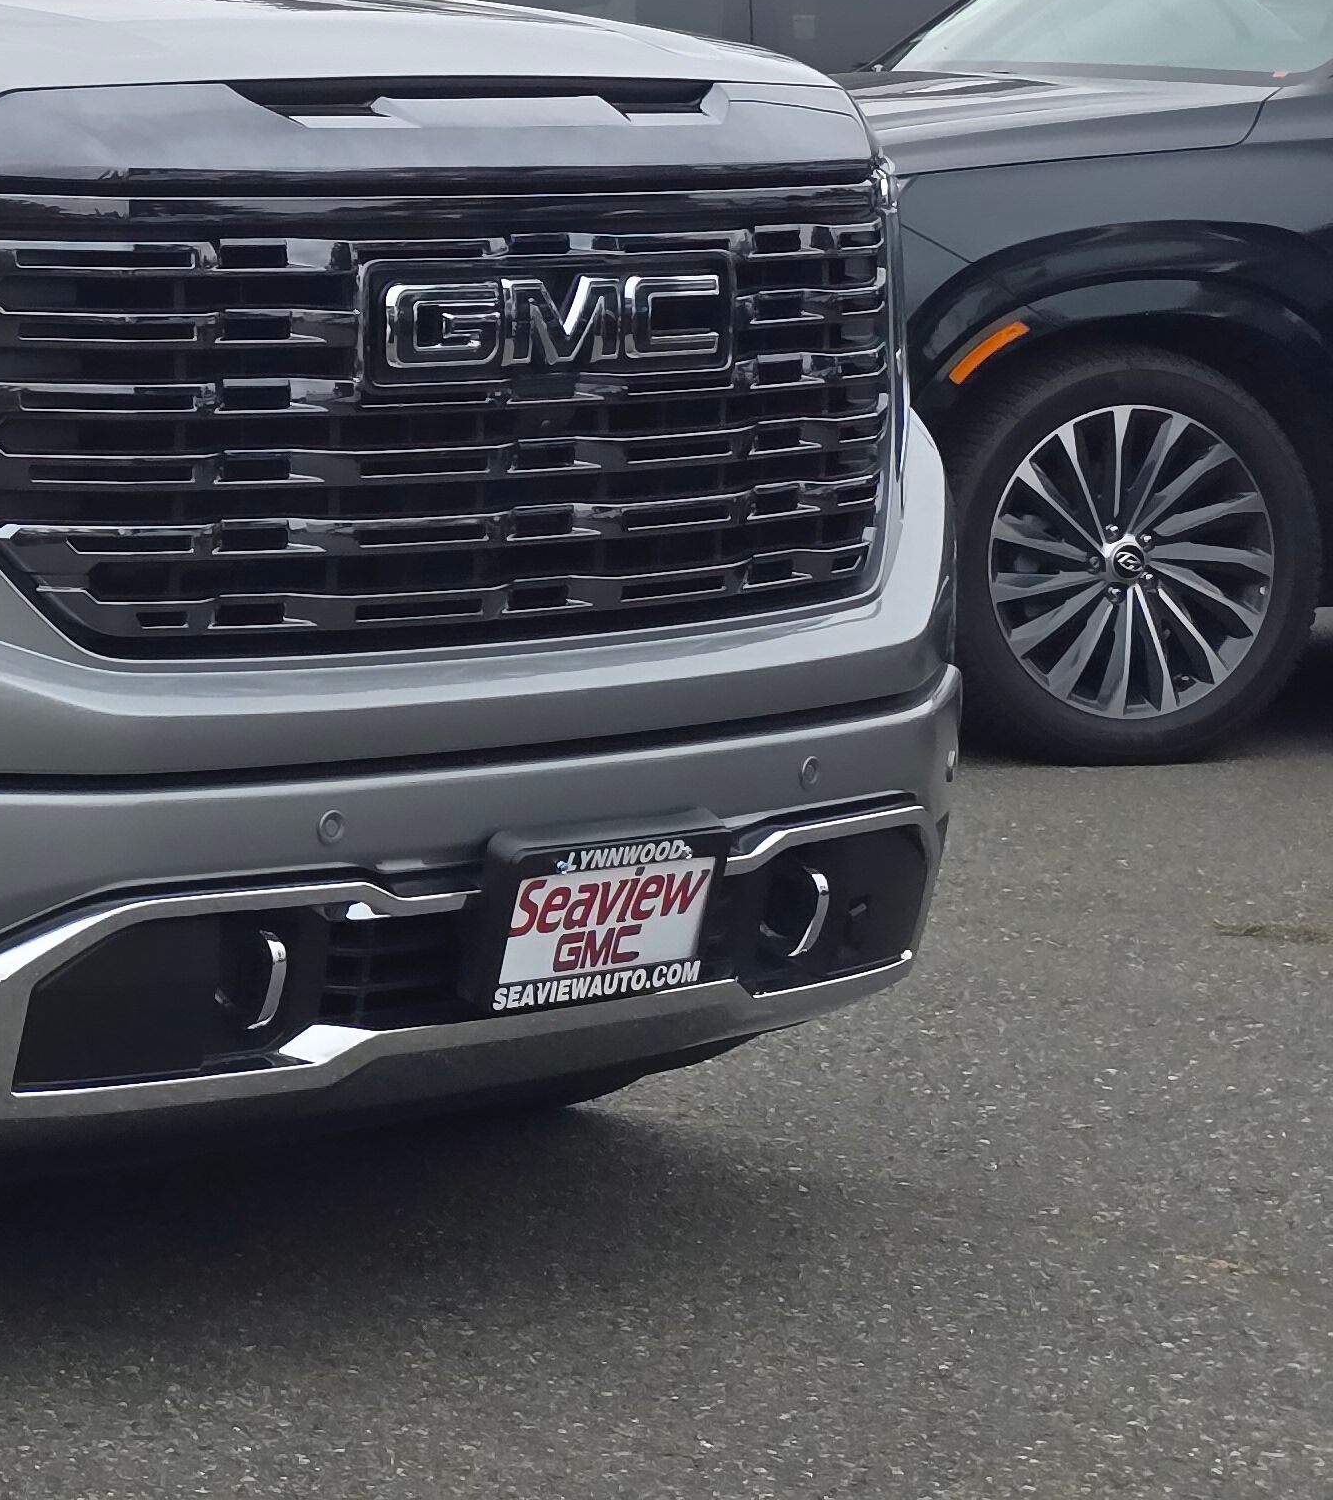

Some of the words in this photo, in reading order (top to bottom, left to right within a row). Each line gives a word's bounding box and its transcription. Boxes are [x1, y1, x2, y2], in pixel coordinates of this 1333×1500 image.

[385, 274, 721, 368] GMC
[566, 839, 686, 873] LYNNWOOD
[508, 866, 711, 938] Seaview
[552, 923, 642, 973] GMC
[492, 960, 701, 1012] SEAVIEWAUTO.COM
